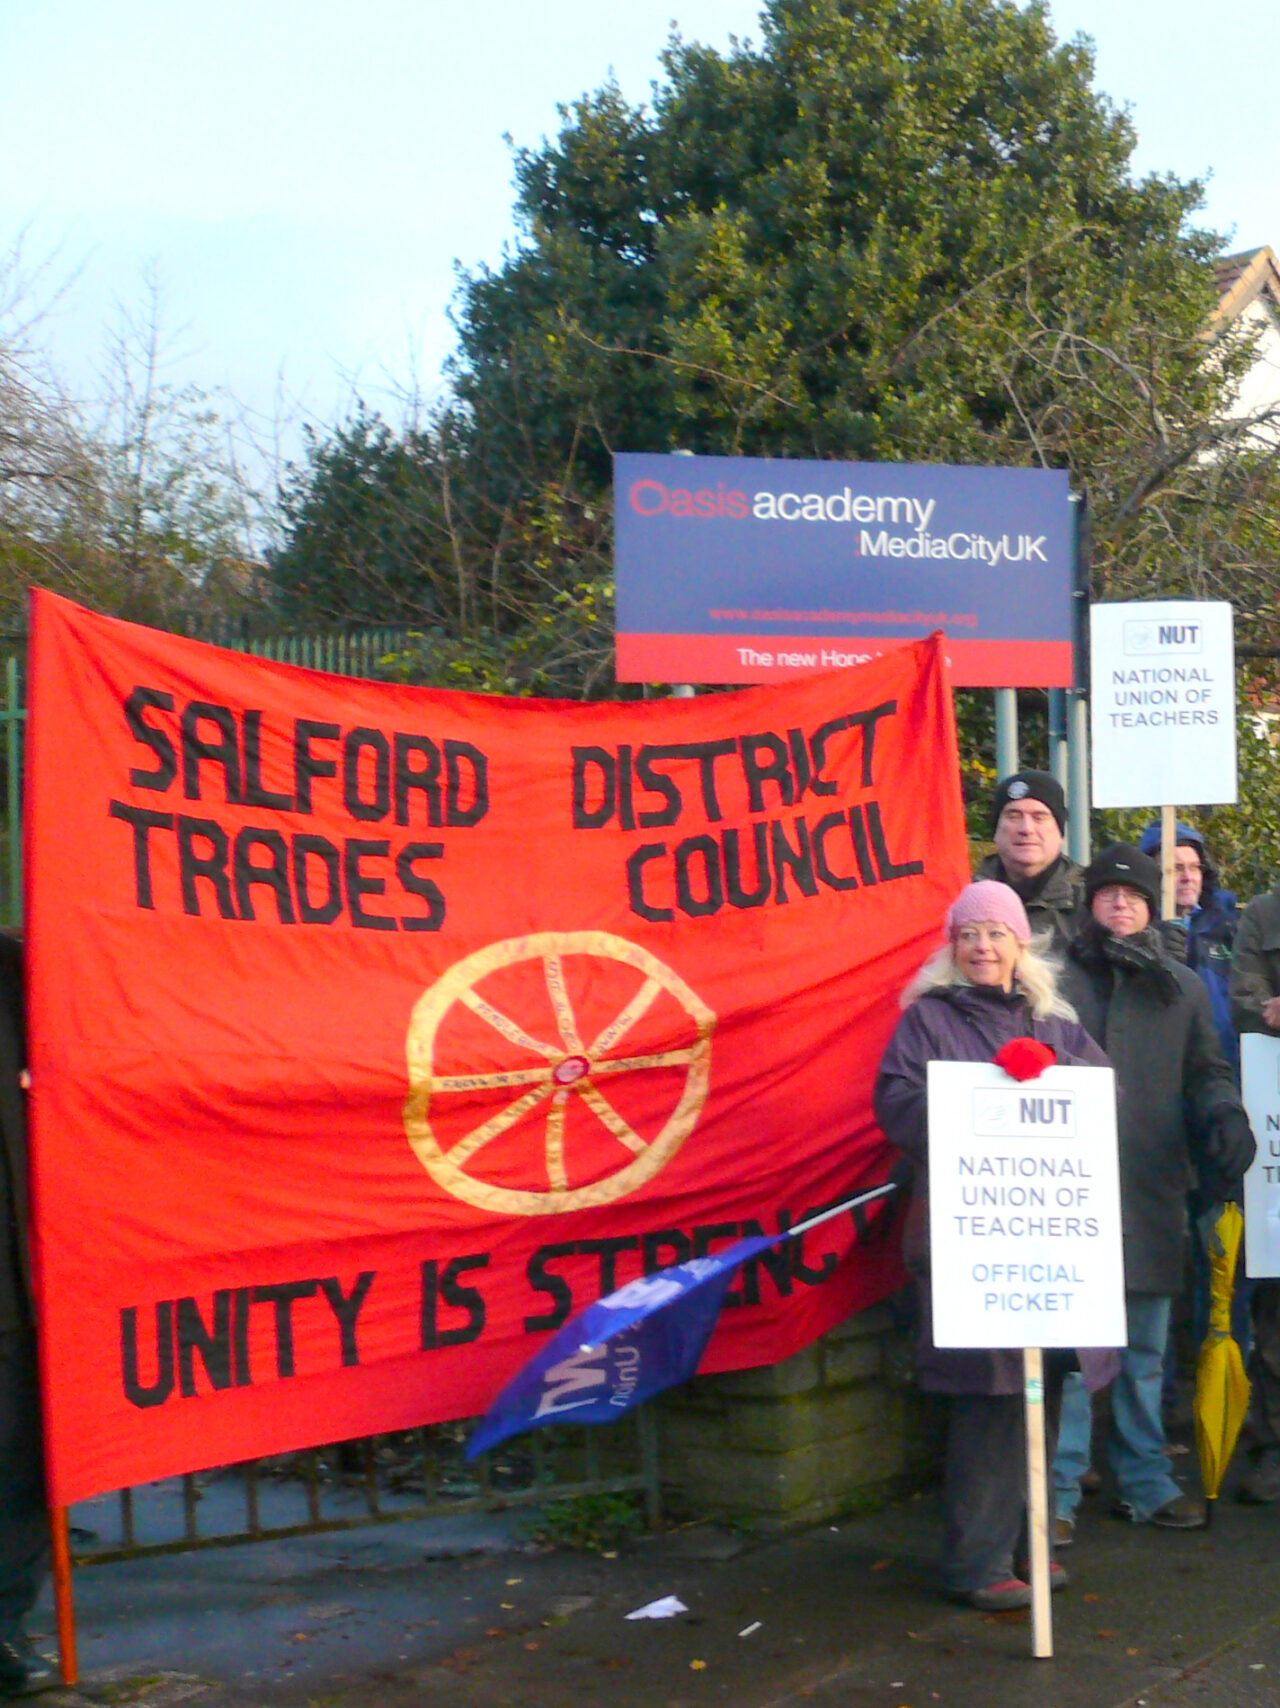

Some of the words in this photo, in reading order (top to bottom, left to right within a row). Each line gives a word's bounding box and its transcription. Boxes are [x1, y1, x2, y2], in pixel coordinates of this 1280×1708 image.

[629, 478, 749, 519] Oasis
[752, 486, 936, 531] academy
[1158, 625, 1199, 645] NUT
[736, 647, 773, 667] The
[777, 651, 818, 667] new
[1112, 668, 1214, 685] NATIONAL
[1114, 689, 1178, 707] UNION
[1185, 688, 1213, 704] OF
[1108, 710, 1219, 728] TEACHERS
[124, 685, 489, 829] SALFORD
[572, 699, 897, 831] DISTRICT
[109, 799, 445, 932] TRADES
[627, 800, 924, 924] COUNCIL
[1019, 1097, 1072, 1125] NUT
[958, 1156, 1092, 1178] NATIONAL
[961, 1186, 1046, 1207] UNION
[1055, 1187, 1090, 1208] OF
[953, 1215, 1100, 1237] TEACHERS
[971, 1263, 1085, 1284] OFFICIAL
[983, 1292, 1075, 1313] PICKET
[118, 1269, 378, 1408] UNITY
[420, 1253, 492, 1350] IS
